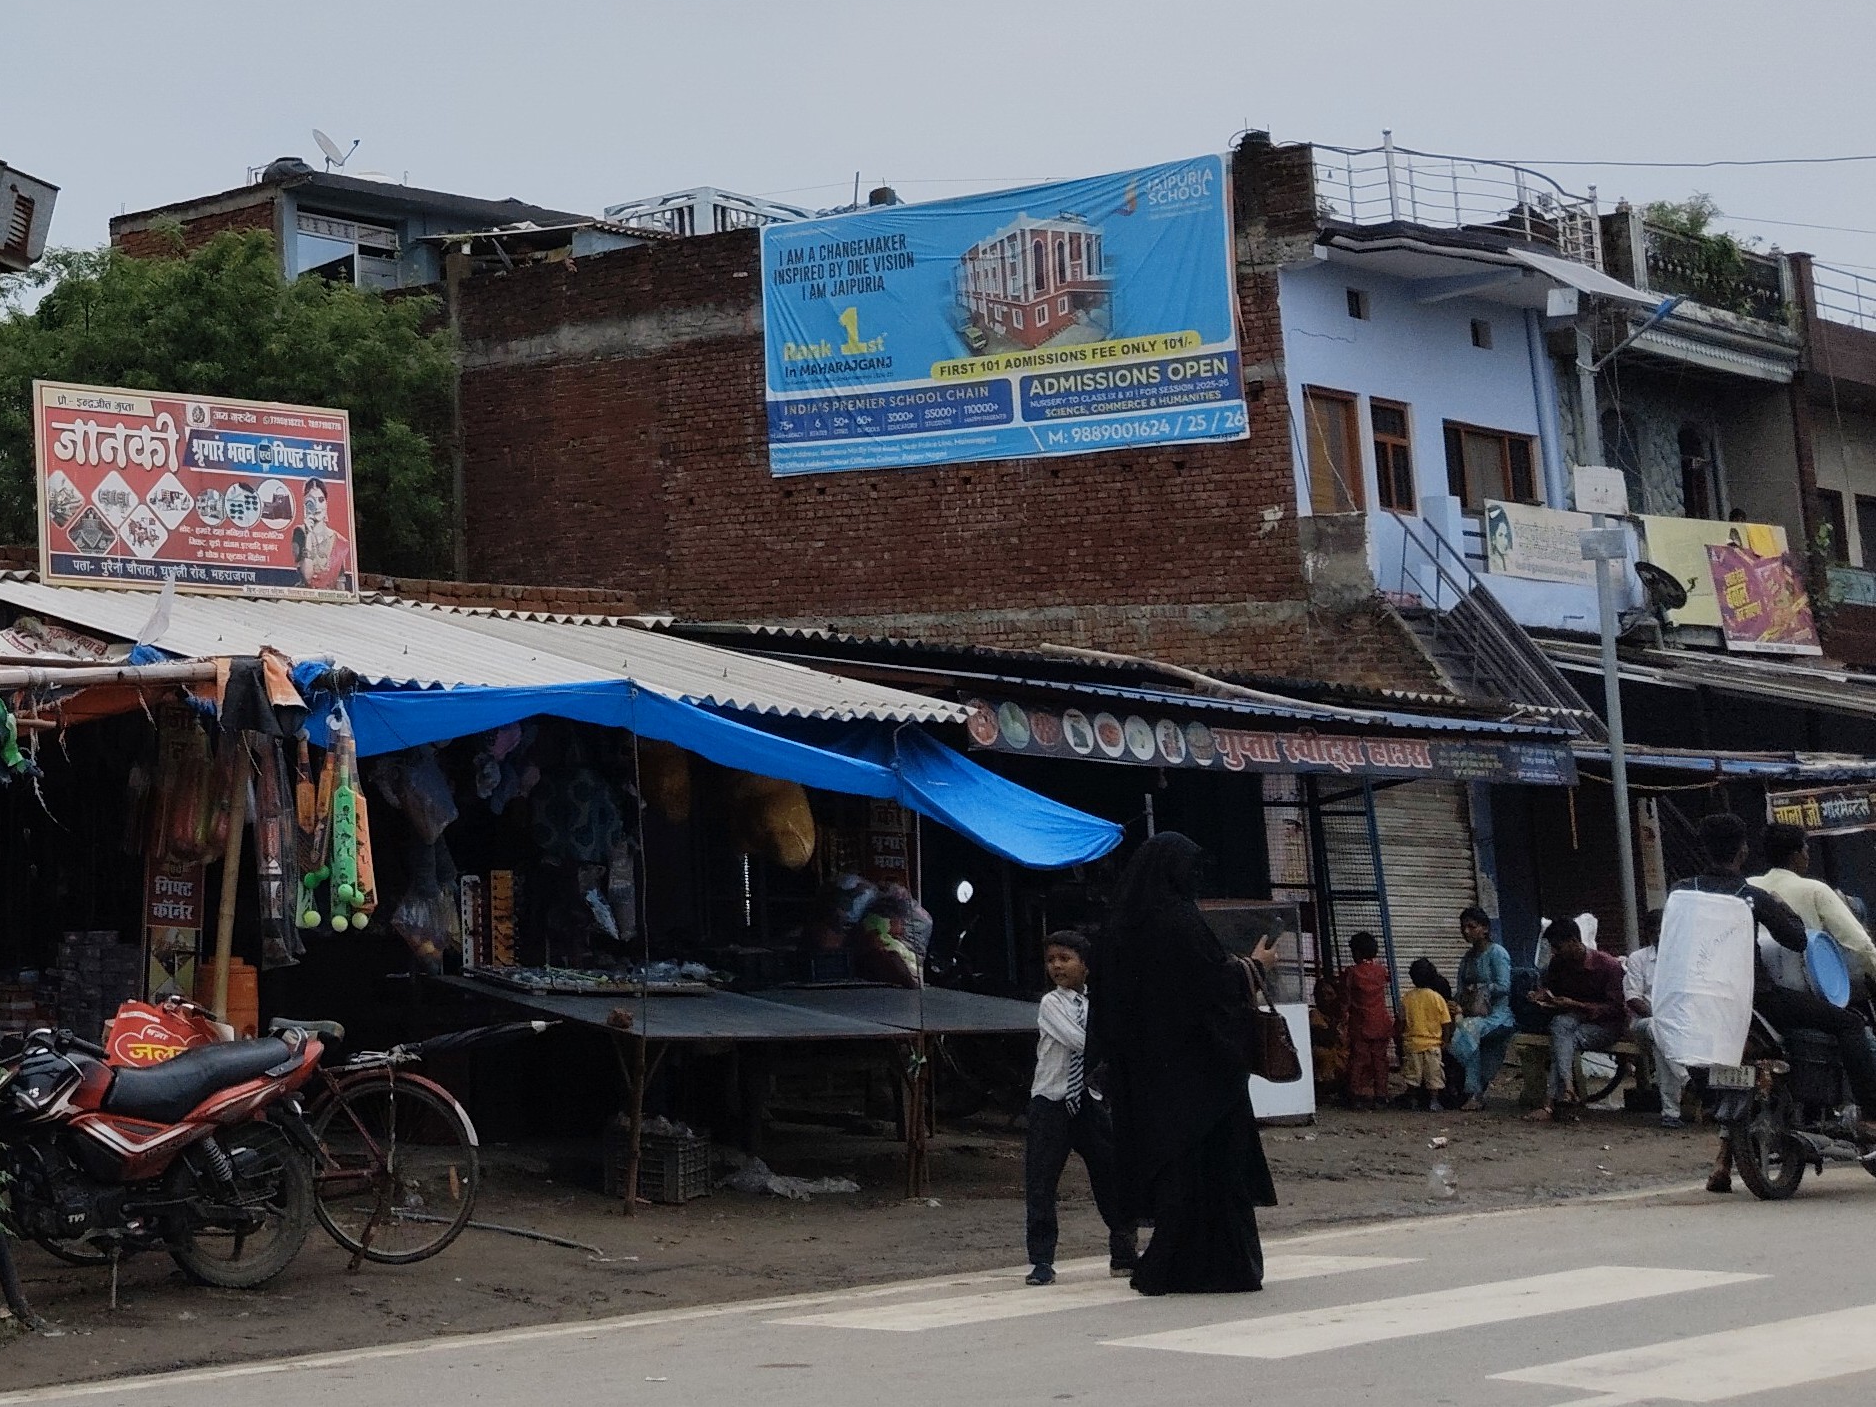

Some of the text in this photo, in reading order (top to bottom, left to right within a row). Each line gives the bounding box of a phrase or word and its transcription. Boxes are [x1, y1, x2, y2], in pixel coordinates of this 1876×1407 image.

[1148, 168, 1214, 193] JAIPURIA
[1148, 184, 1211, 205] SCHOOL
[787, 249, 804, 265] AM
[808, 246, 816, 262] A
[819, 233, 907, 261] CHANGEMAKER
[774, 251, 915, 286] INSPIRED BY ONE VISION
[810, 281, 826, 300] AM
[830, 275, 885, 297] JAIPURIA
[784, 339, 831, 361] Rank
[939, 338, 1193, 377] FIRST 101 ADMISSIONS FEE ONLY 101/-
[785, 356, 893, 377] In MAHARAJGANJ
[1030, 357, 1229, 397] ADMISSIONS OPEN
[784, 386, 989, 416] INDIA'S PREMIER SCHOOL CHAIN
[1030, 397, 1067, 408] NURSERY
[1068, 396, 1079, 404] TO
[1140, 388, 1153, 396] FOR
[1158, 383, 1194, 394] SESSION
[1091, 400, 1148, 413] COMMERCE
[1150, 398, 1157, 407] &
[1159, 390, 1221, 405] HUMANITIES
[1048, 429, 1069, 446] M:
[1073, 420, 1170, 443] 9889001624
[1187, 414, 1207, 432] 25
[1225, 409, 1243, 427] 26
[51, 411, 180, 472] जानकी
[227, 442, 257, 465] भवन
[273, 440, 304, 468] गिफ्ट
[305, 442, 340, 472] कॉर्नर
[210, 568, 256, 584] महराजगंज
[1210, 727, 1280, 771] गुप्ता
[1363, 736, 1432, 769] हाउस
[154, 874, 194, 896] गिफ्ट
[151, 898, 195, 920] कॉर्नर
[68, 1212, 87, 1223] TVS
